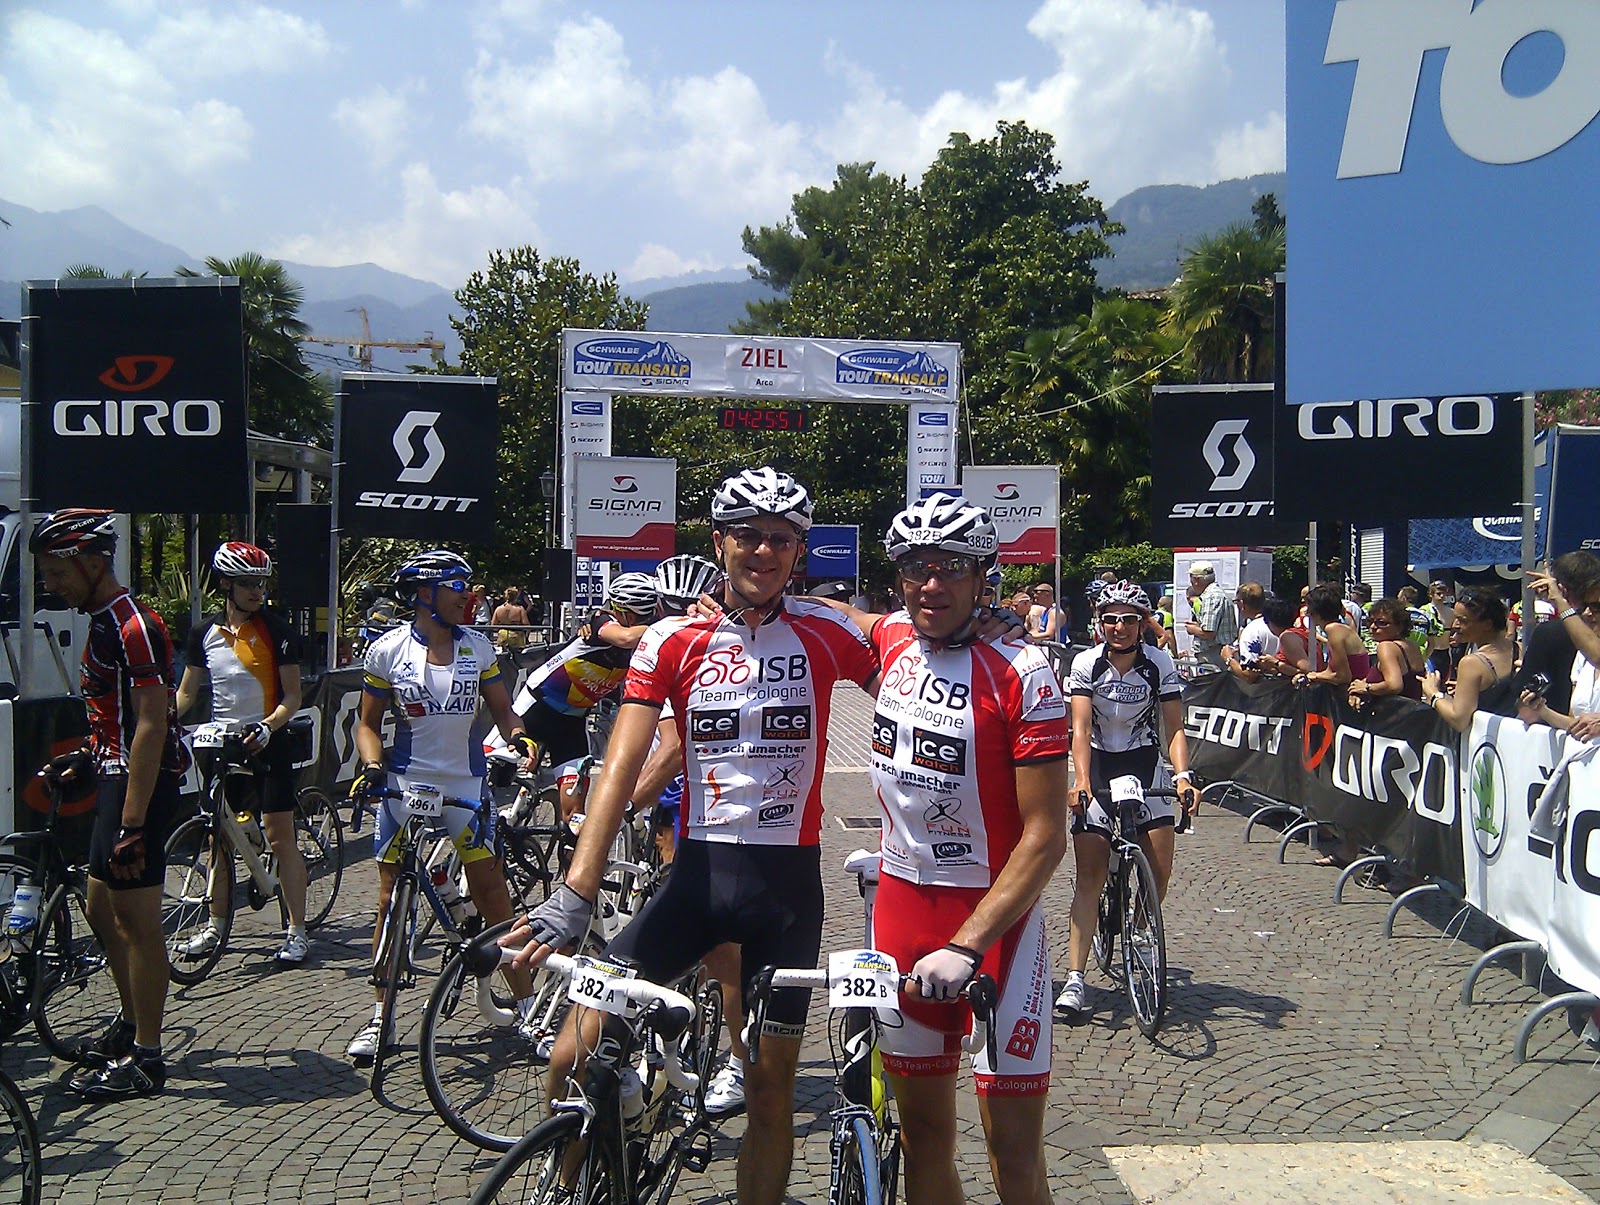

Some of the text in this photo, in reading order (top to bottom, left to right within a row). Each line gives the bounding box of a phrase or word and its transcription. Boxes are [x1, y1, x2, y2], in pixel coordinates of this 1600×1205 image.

[588, 345, 640, 355] SCHWALBE
[741, 347, 788, 368] ZIEL
[850, 356, 900, 365] SCHWALBE
[613, 362, 690, 377] TRANSALP
[755, 378, 774, 386] Arco
[874, 371, 947, 386] TRANSALP
[53, 399, 222, 436] GIRO
[1299, 397, 1495, 440] GIRO
[355, 491, 479, 512] SCOTT
[588, 498, 662, 512] SIGMA
[592, 544, 660, 552] www.sigmasport.com
[968, 534, 994, 550] 382B
[757, 654, 808, 684] ISB
[698, 686, 807, 703] Team-Cologne
[918, 672, 970, 711] ISB
[880, 689, 965, 730] eam-Cologne
[693, 711, 734, 732] ice
[765, 708, 807, 730] ice
[693, 732, 735, 740] watch
[765, 729, 807, 739] watch
[872, 721, 894, 745] ce
[1184, 704, 1293, 756] SCOTT
[721, 744, 807, 755] schumacher
[872, 740, 893, 757] atch
[914, 730, 959, 762] ice
[914, 756, 959, 773] watch
[1331, 723, 1456, 826] GIRO
[409, 798, 435, 812] 496 A
[925, 822, 970, 835] FUN
[928, 830, 972, 838] FITNESS
[576, 975, 615, 1004] 382 A
[842, 977, 889, 999] 382 B
[975, 1077, 1039, 1092] Team-Cologne
